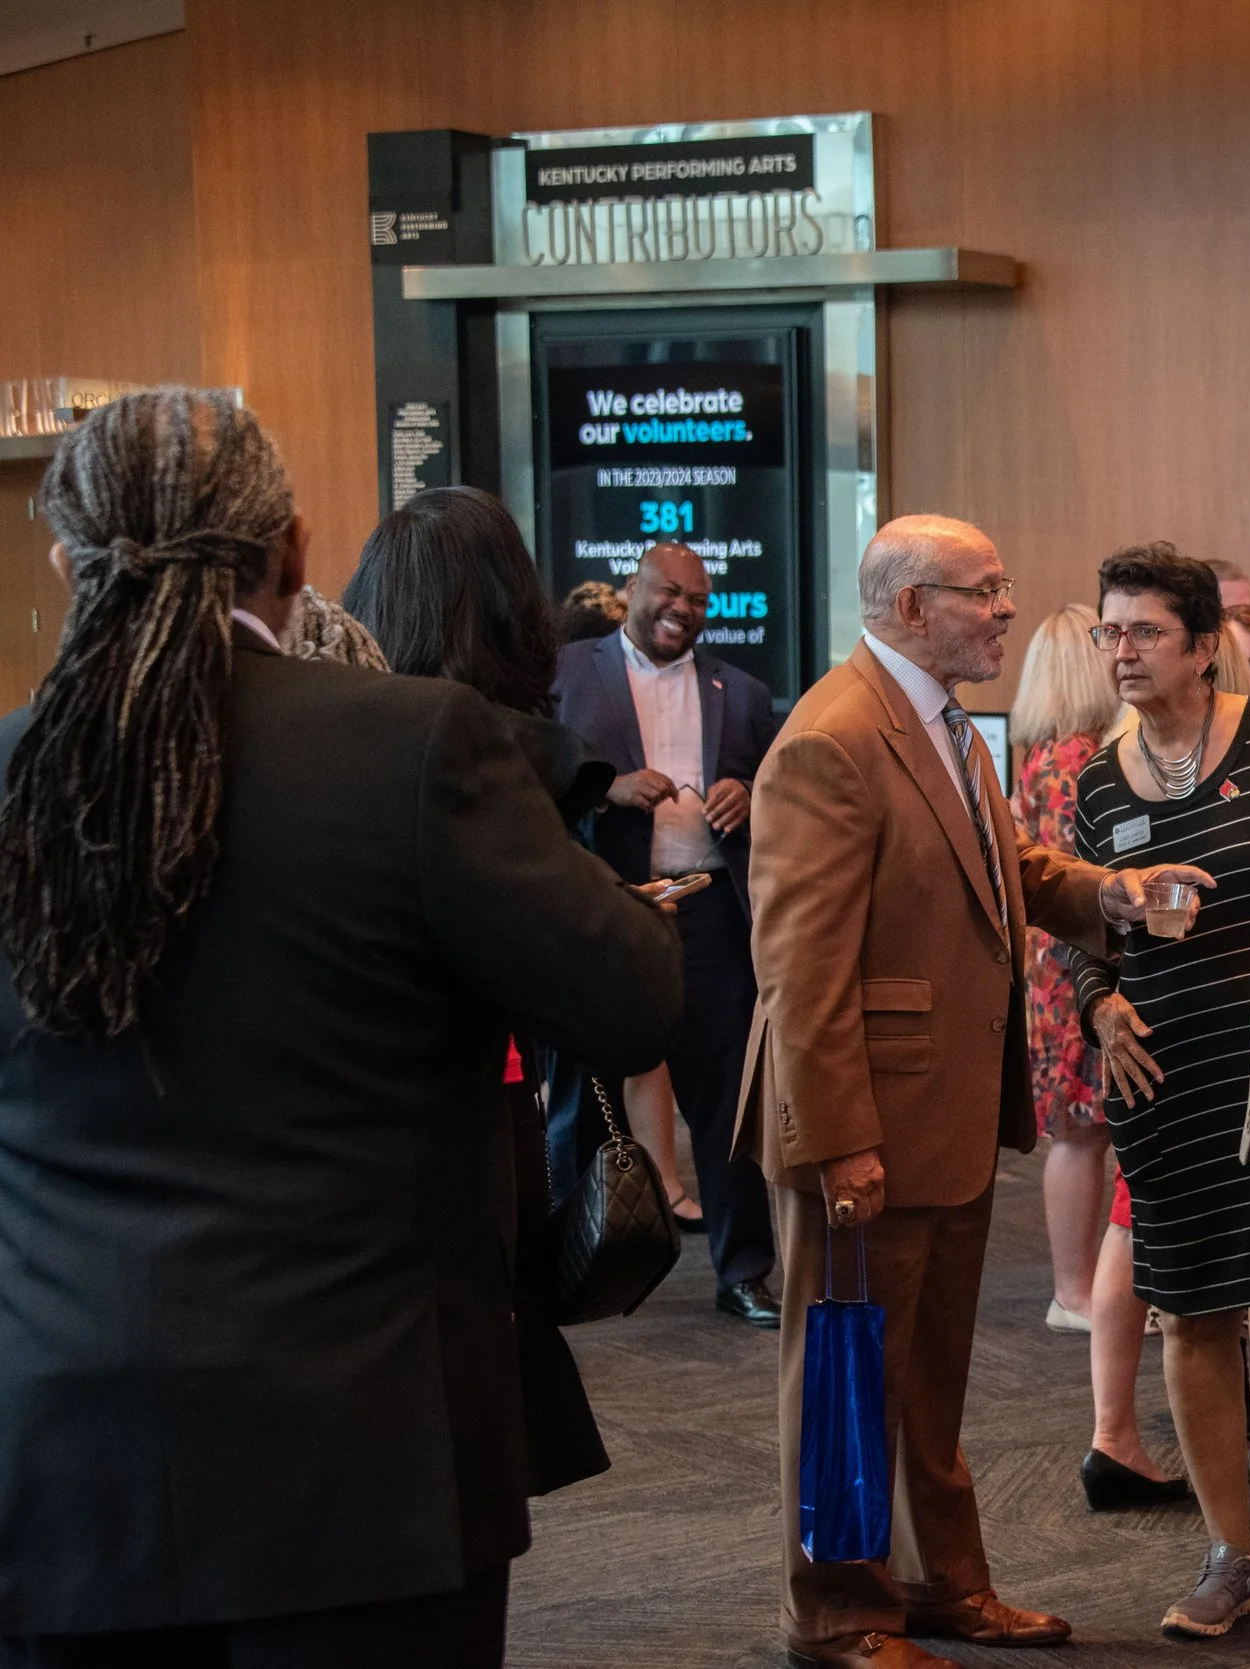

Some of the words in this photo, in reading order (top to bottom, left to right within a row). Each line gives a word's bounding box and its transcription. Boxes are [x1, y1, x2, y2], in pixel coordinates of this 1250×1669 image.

[538, 164, 628, 187] KENTUCKY
[631, 157, 745, 181] PERFORMING
[748, 153, 797, 175] ARTS
[522, 188, 824, 266] CONTRIBUTORS
[71, 391, 112, 409] ORC
[587, 390, 627, 416] We
[630, 388, 743, 415] celebrate
[579, 422, 620, 445] our
[622, 417, 753, 443] volunteers.
[597, 468, 611, 487] IN
[612, 468, 633, 486] THE
[692, 466, 736, 485] SEASON
[640, 501, 693, 533] 381
[575, 540, 644, 560] Kentucky
[728, 538, 762, 557] Arts
[705, 592, 768, 618] ours
[704, 627, 746, 644] value
[747, 626, 765, 644] of
